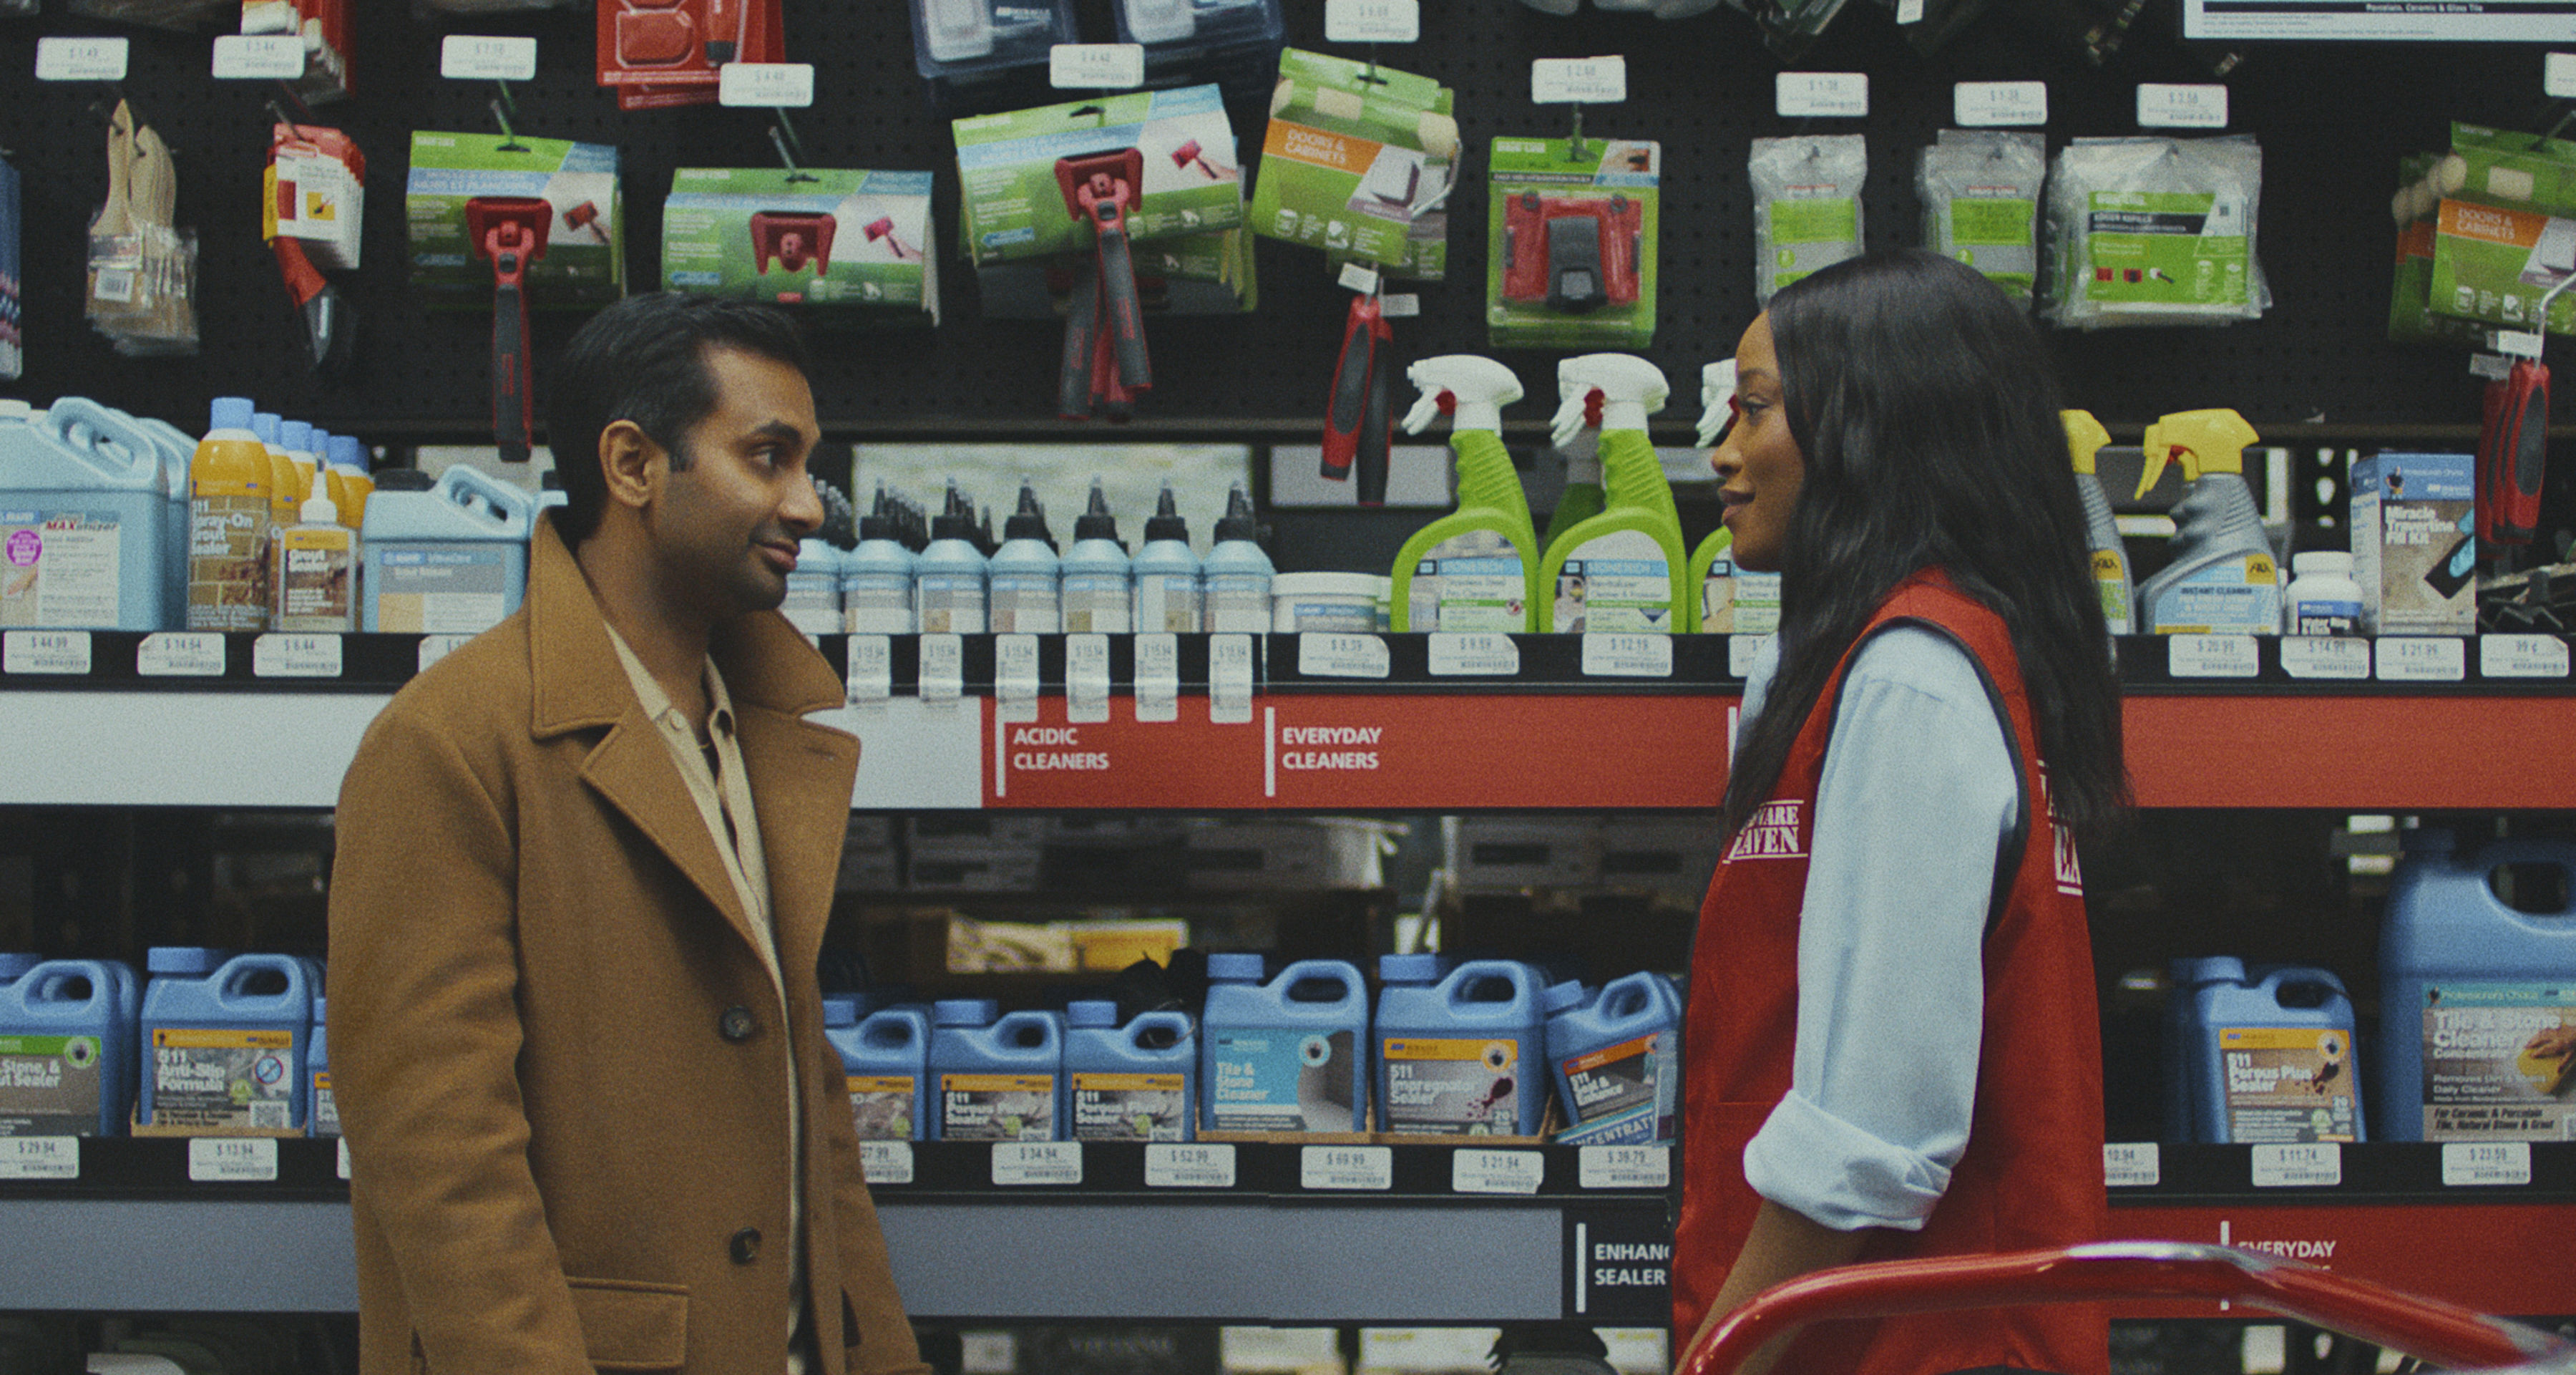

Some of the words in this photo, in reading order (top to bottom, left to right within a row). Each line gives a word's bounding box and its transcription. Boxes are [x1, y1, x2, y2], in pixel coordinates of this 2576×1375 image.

[2385, 505, 2436, 520] Miracle
[2385, 520, 2457, 533] Travertine
[1014, 728, 1078, 744] ACIDIC
[1283, 727, 1382, 744] EVERYDAY
[1014, 754, 1109, 769] CLEANERS
[1283, 753, 1379, 769] CLEANERS
[2434, 1010, 2475, 1030] Tile
[2503, 1011, 2562, 1030] Stone
[2434, 1029, 2517, 1048] Cleaner
[158, 1049, 187, 1064] 511
[2227, 1053, 2251, 1069] 511
[158, 1064, 225, 1079] Anti-Slip
[1216, 1063, 1241, 1075] Tile
[1244, 1063, 1255, 1076] &
[1390, 1064, 1413, 1079] 511
[2228, 1067, 2280, 1080] Porous
[2280, 1064, 2313, 1080] Plus
[14, 1072, 62, 1088] Sealer
[158, 1079, 225, 1092] Formula
[1216, 1076, 1254, 1089] Stone
[2230, 1079, 2277, 1092] Sealer
[1216, 1089, 1269, 1101] Cleaner
[2434, 1085, 2458, 1095] Daily
[2461, 1084, 2502, 1094] Cleaner
[1390, 1092, 1436, 1104] Sealer
[1595, 1269, 1666, 1285] SEALER
